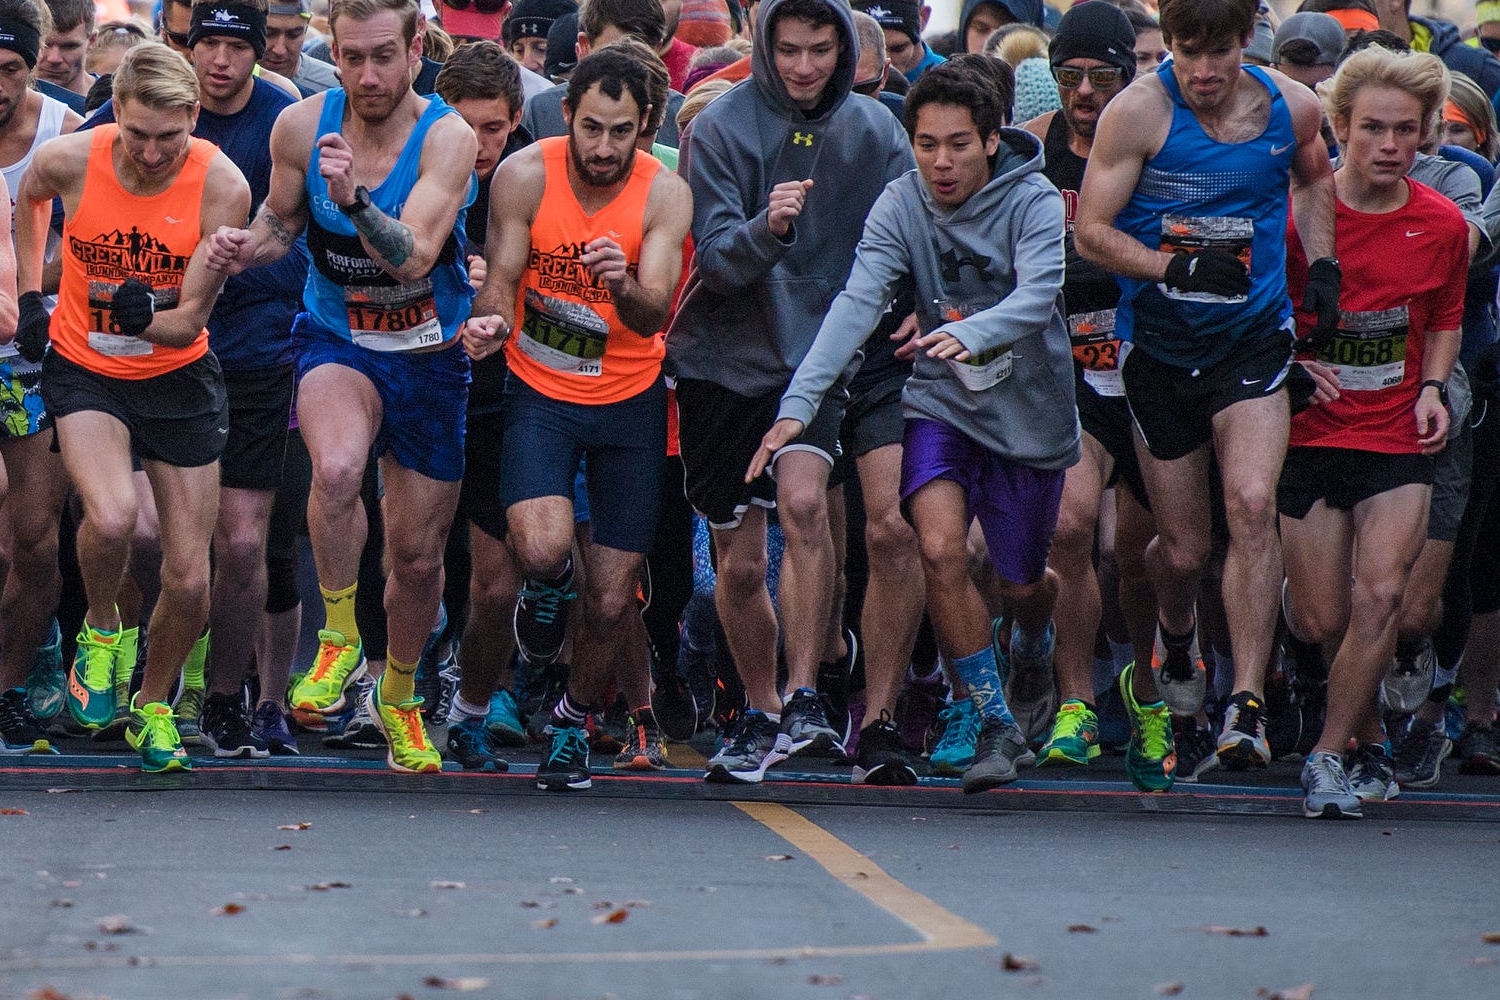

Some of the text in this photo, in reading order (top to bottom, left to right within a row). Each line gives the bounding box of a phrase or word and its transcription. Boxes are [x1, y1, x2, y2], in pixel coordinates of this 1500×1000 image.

[326, 249, 379, 268] PERFORM
[351, 303, 421, 331] 1780
[418, 332, 440, 344] 1780
[1084, 343, 1116, 369] 23
[1318, 339, 1393, 367] 4068
[578, 365, 599, 373] 4171
